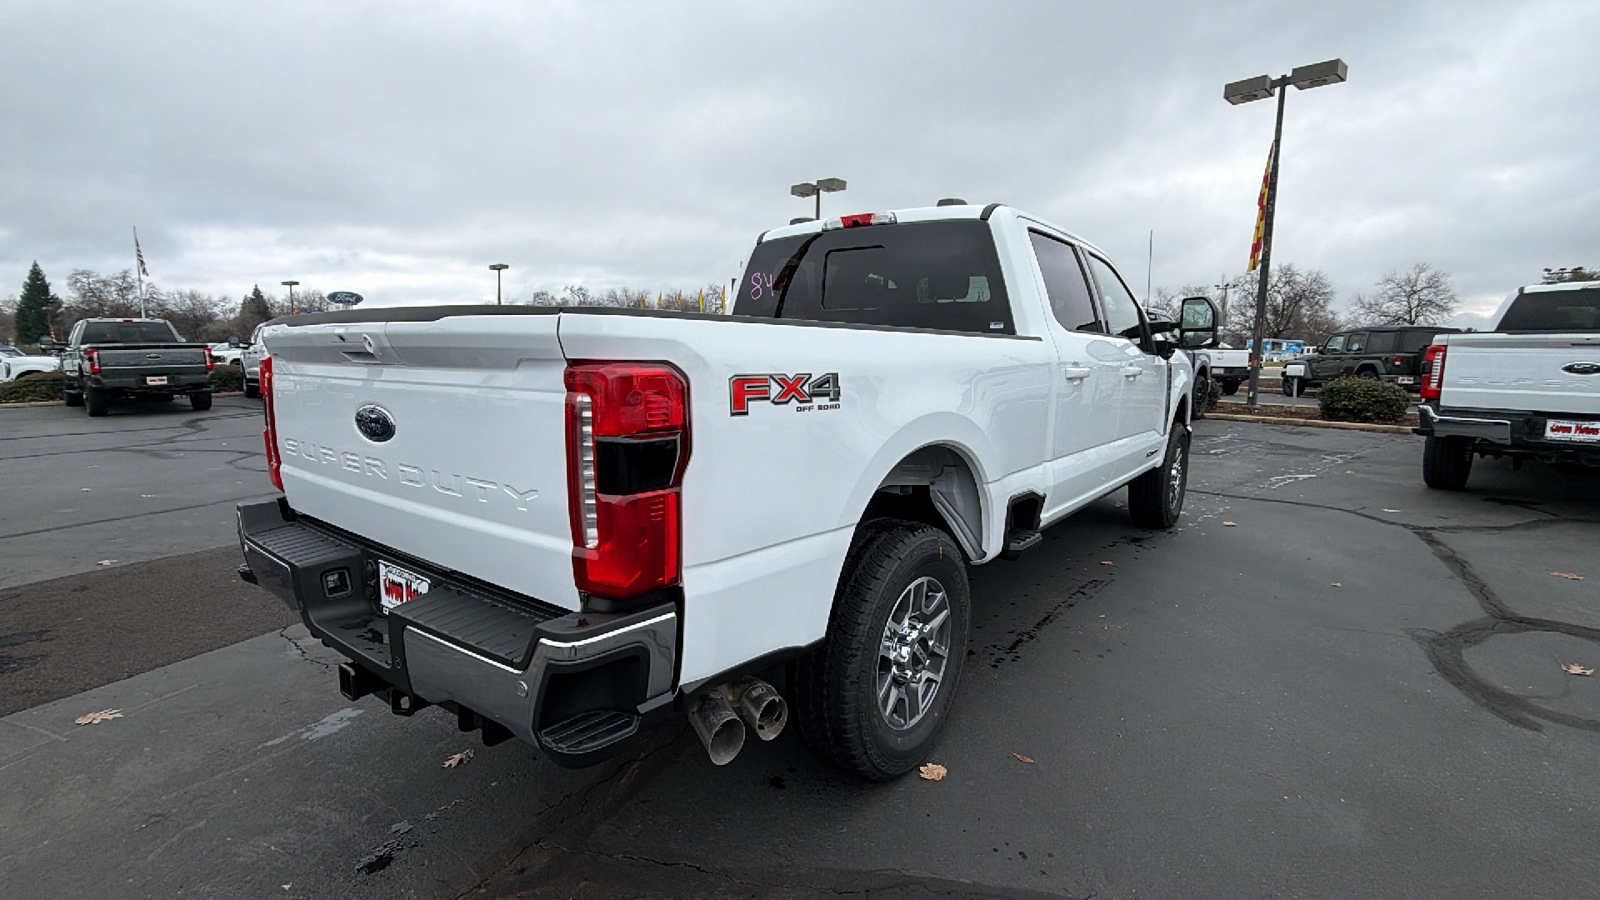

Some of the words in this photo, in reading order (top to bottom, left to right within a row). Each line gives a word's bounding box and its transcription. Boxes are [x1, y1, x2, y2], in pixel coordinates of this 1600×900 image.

[751, 271, 774, 300] 84
[728, 372, 841, 417] FX4
[796, 405, 814, 413] OFF
[817, 403, 841, 411] ROAD
[284, 437, 388, 480] SUPER
[399, 462, 539, 512] DUTY
